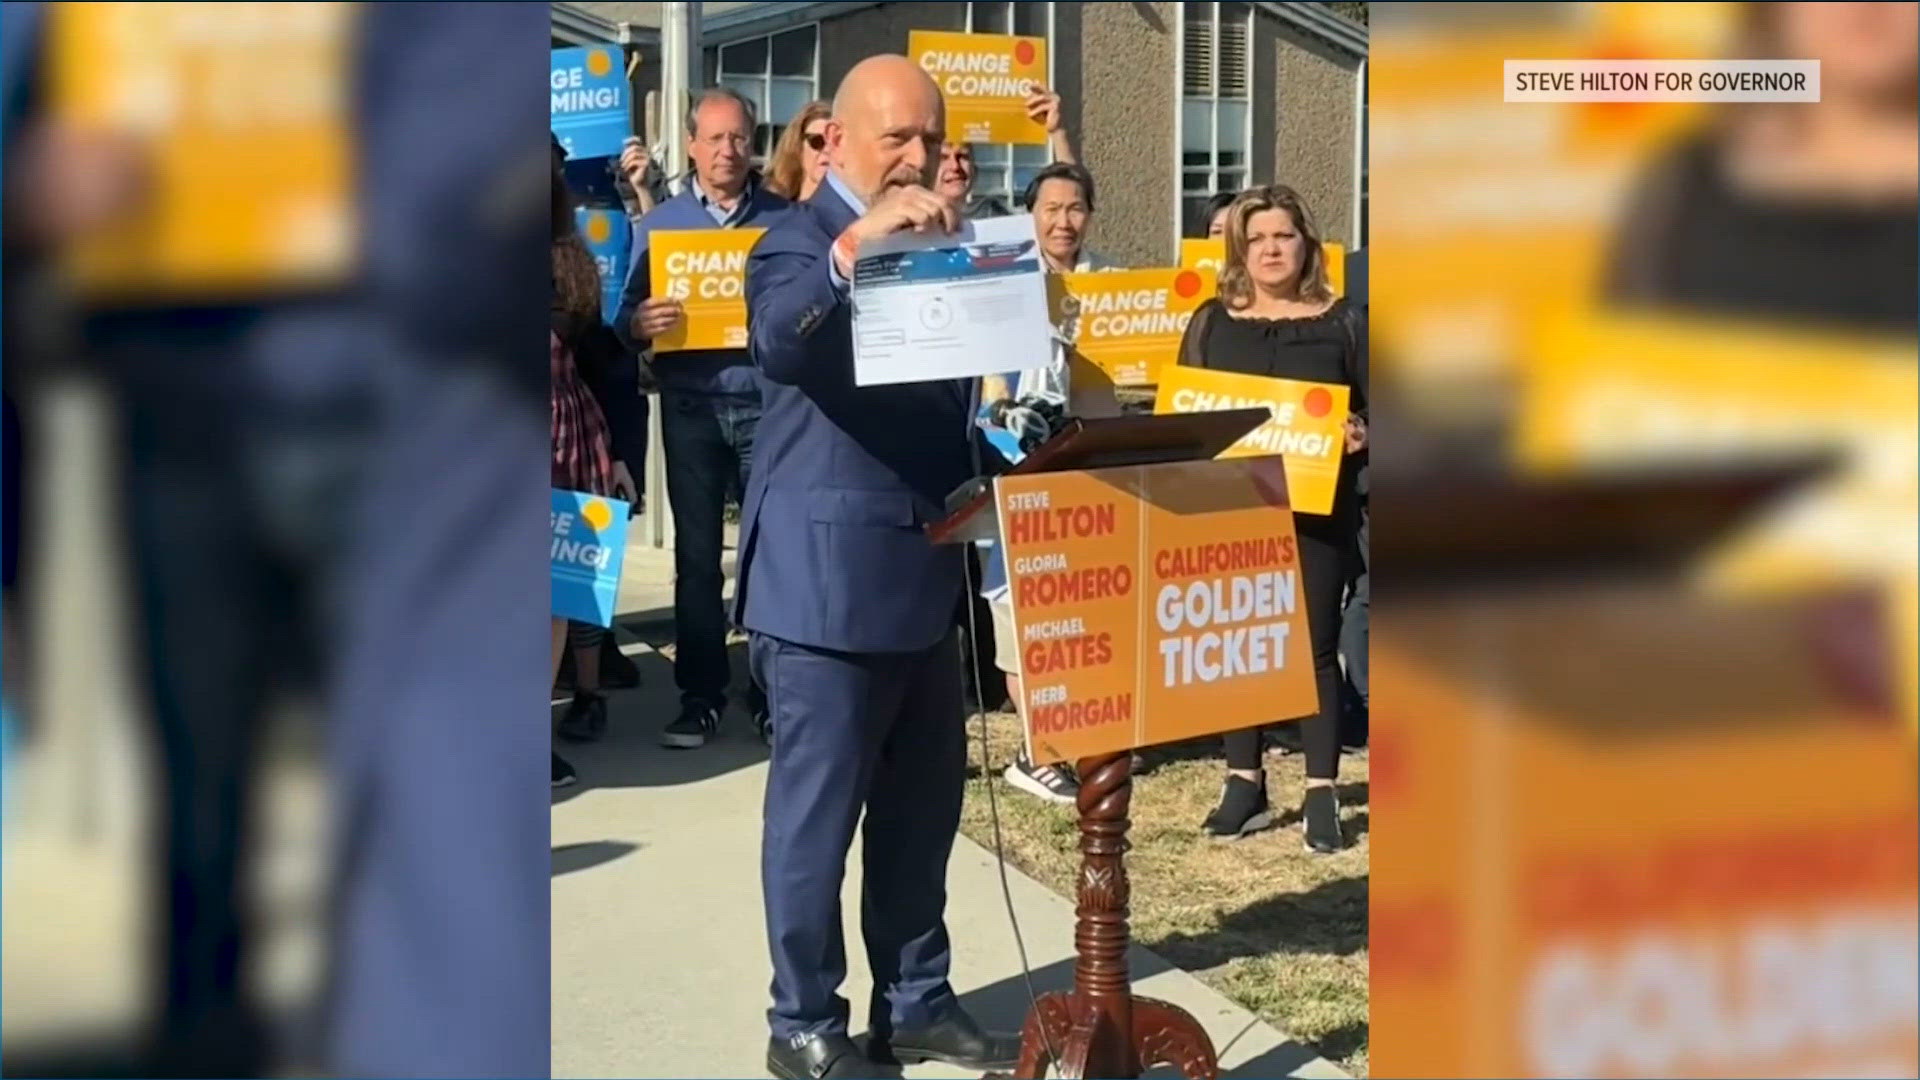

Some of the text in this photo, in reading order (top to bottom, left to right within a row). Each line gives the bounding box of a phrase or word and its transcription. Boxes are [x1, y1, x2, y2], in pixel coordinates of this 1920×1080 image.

[920, 50, 1011, 73] CHANGE
[665, 250, 747, 275] CHAN
[666, 276, 744, 301] IS CO
[1060, 288, 1168, 316] CHANGE
[1008, 491, 1050, 511] STEVE
[1010, 503, 1115, 545] HILTON
[1015, 553, 1067, 574] GLORIA
[1155, 535, 1294, 579] CALIFORNIA'S
[1018, 564, 1132, 609] ROMERO
[1156, 569, 1296, 632] GOLDEN
[1024, 617, 1086, 640] MICHAEL
[1024, 632, 1112, 676] GATES
[1159, 622, 1290, 688] TICKET
[1031, 684, 1067, 706] HERB
[1032, 693, 1132, 736] MORGAN
